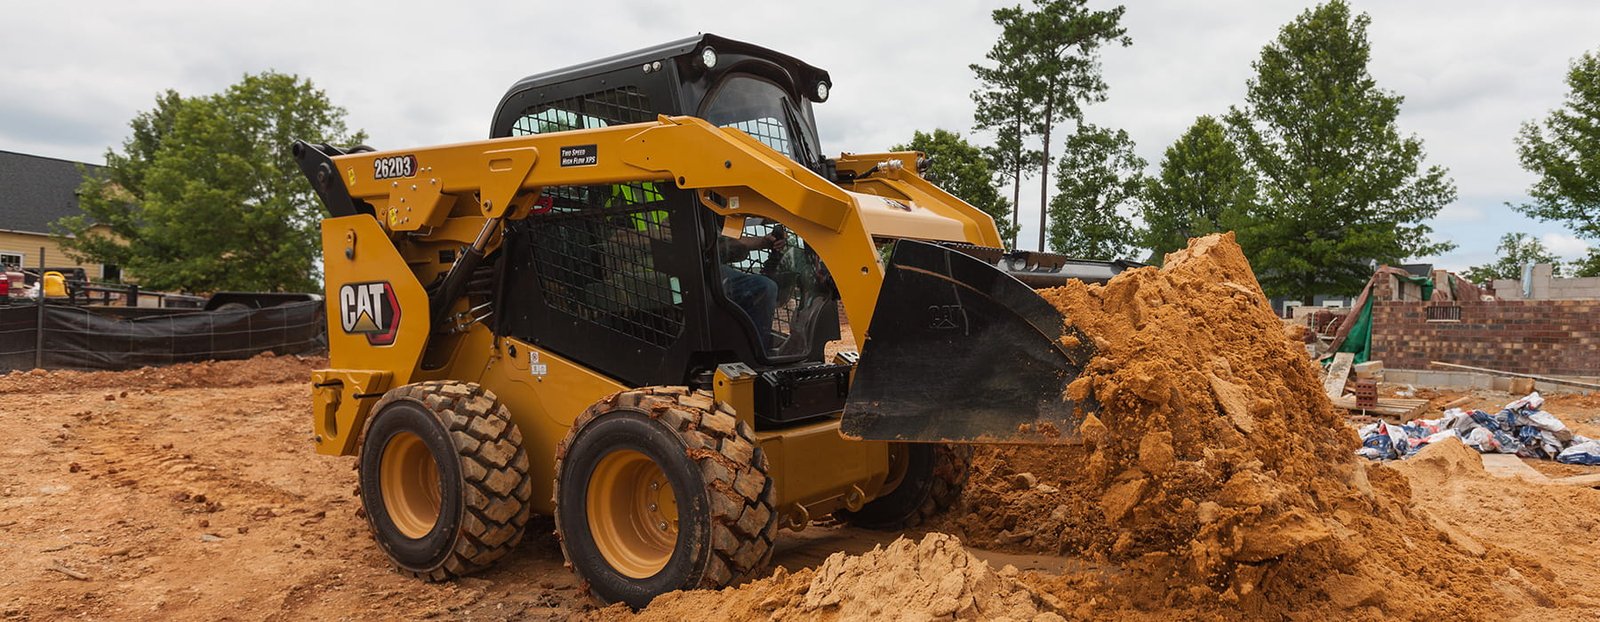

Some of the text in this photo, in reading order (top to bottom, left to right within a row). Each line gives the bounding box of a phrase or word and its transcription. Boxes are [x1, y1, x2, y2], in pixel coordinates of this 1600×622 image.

[374, 156, 411, 178] 262D3
[340, 283, 384, 332] CAT
[928, 304, 961, 329] CAT
